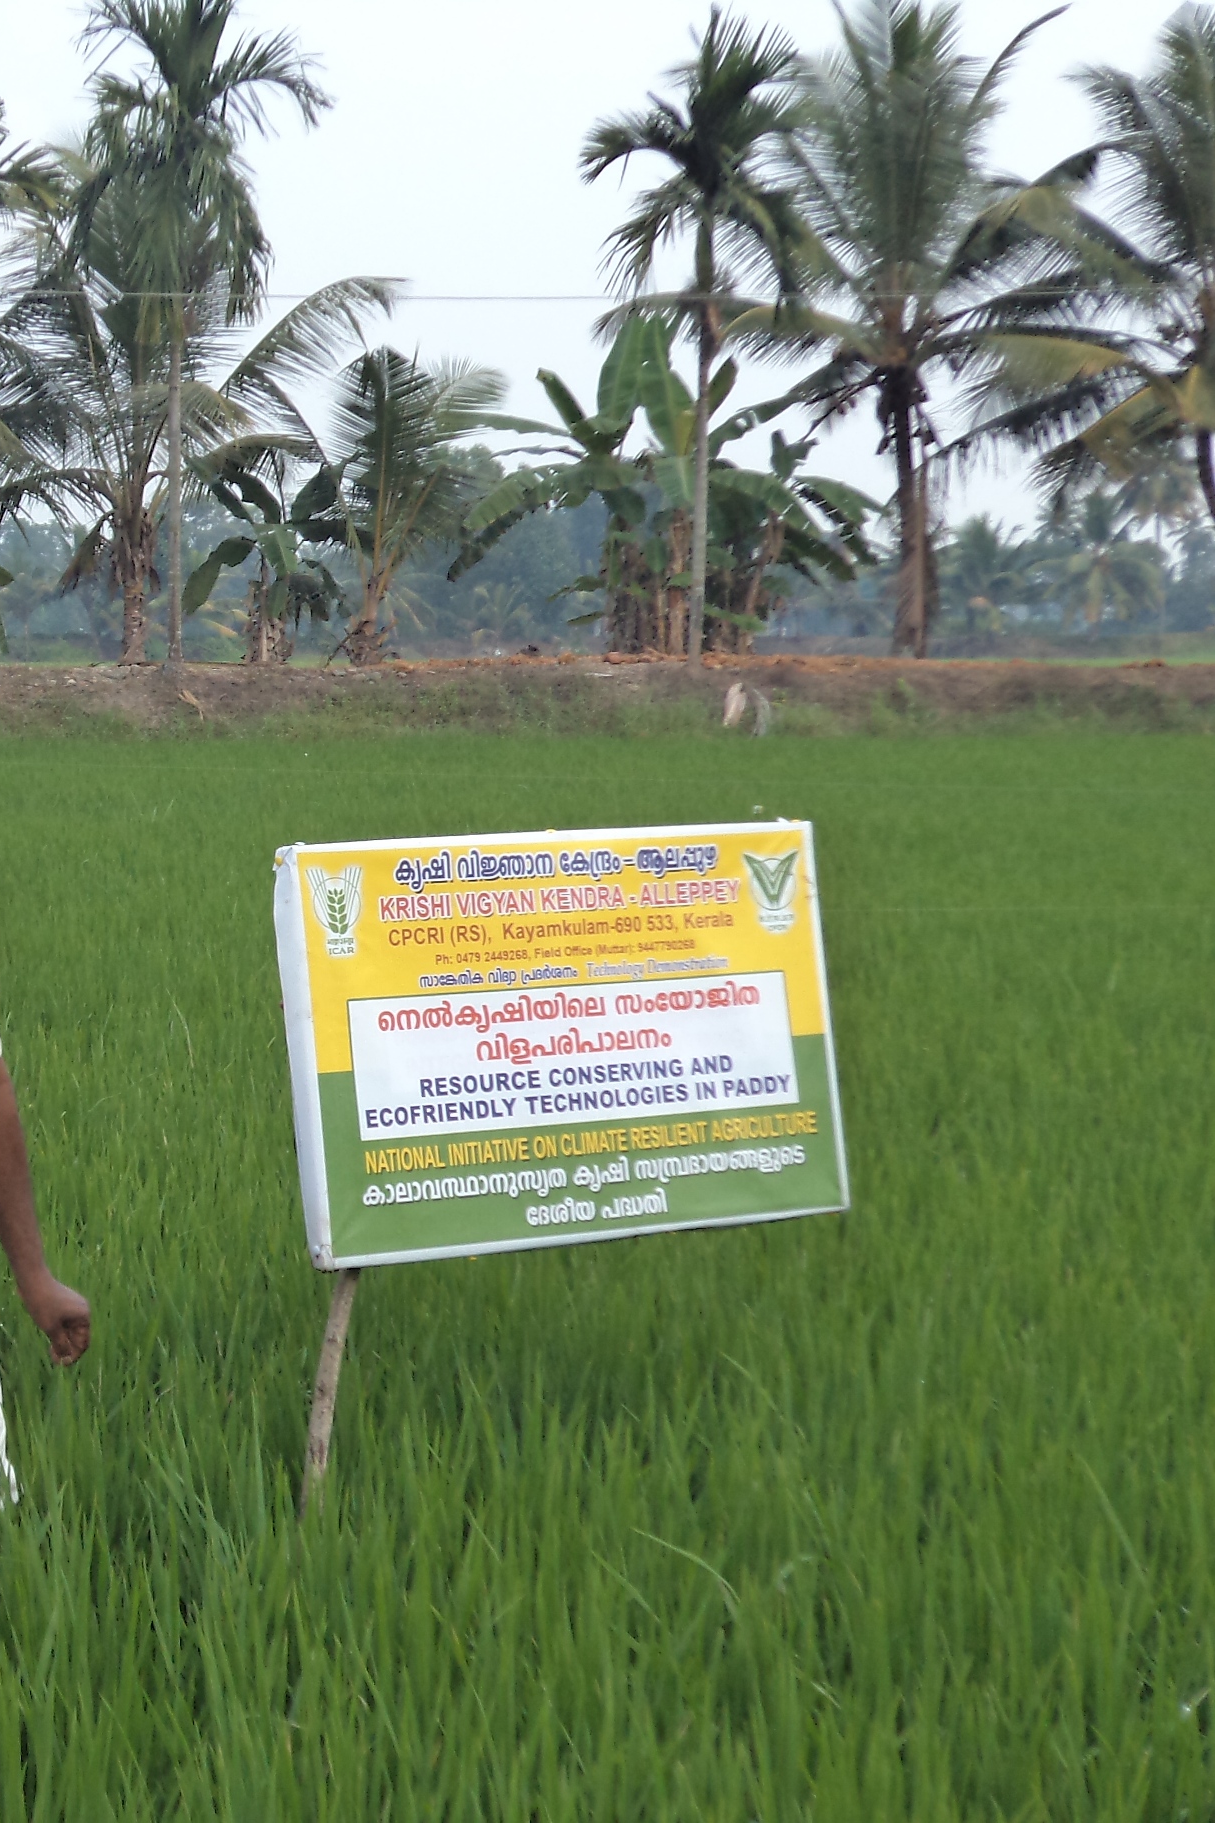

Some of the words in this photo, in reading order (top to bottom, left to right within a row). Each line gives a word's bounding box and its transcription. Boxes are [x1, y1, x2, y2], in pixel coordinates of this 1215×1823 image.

[396, 851, 451, 890] കൃഷി
[380, 894, 450, 920] KRISHI
[457, 890, 535, 916] VIGYAN
[540, 885, 624, 911] KENDRA
[640, 880, 739, 905] ALLEPPEY
[389, 929, 444, 946] CPCRI
[450, 924, 491, 947] (RS),
[503, 916, 641, 943] Kayamkulam-690
[648, 914, 678, 933] 533,
[685, 912, 733, 929] Kerala
[328, 947, 355, 955] ICAR
[435, 954, 453, 965] Ph:
[457, 952, 480, 963] 0479
[535, 947, 561, 959] Field
[565, 946, 592, 957] Office
[587, 960, 643, 979] Technology
[615, 981, 760, 1014] സംയോജിത
[477, 1027, 672, 1064] വിളപരിപാലനം
[420, 1070, 541, 1098] RESOURCE
[549, 1059, 683, 1087] CONSERVING
[691, 1055, 733, 1075] AND
[365, 1098, 516, 1128] ECOFRIENDLY
[525, 1083, 688, 1115] TECHNOLOGIES
[696, 1081, 718, 1100] IN
[724, 1074, 791, 1098] PADDY
[365, 1145, 445, 1174] NATIONAL
[448, 1137, 530, 1167] INITIATIVE
[534, 1134, 558, 1159] ON
[560, 1128, 627, 1157] CLIMATE
[631, 1120, 707, 1149] RESILIENT
[712, 1110, 818, 1142] AGRICULTURE
[573, 1156, 630, 1192] കൃഷി
